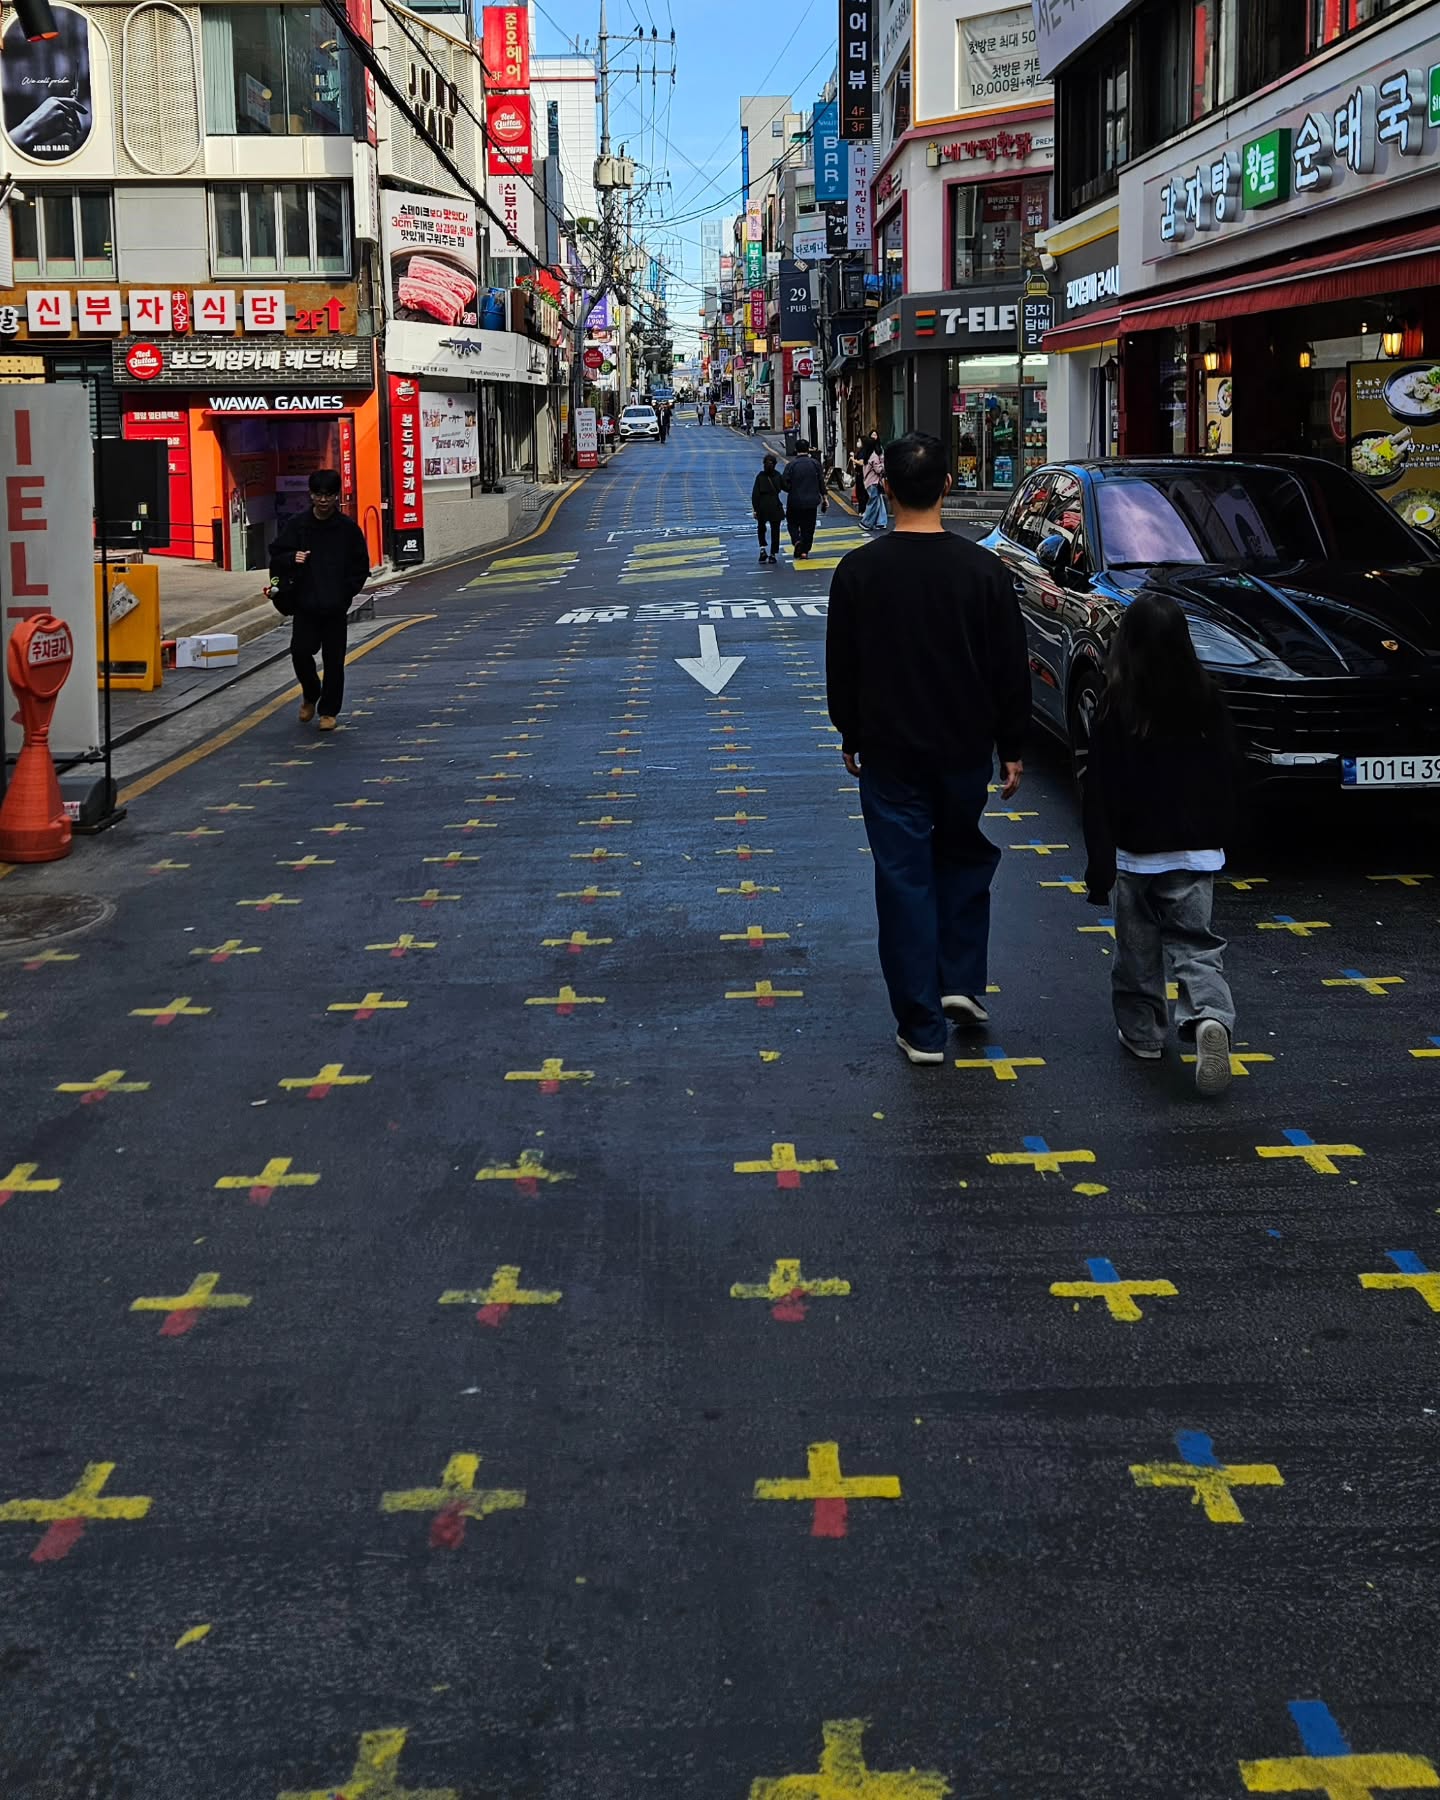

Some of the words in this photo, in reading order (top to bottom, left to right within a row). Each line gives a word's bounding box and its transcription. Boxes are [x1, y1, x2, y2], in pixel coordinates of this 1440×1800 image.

[505, 13, 522, 82] 준오헤어
[848, 0, 867, 90] 어더뷰
[969, 38, 996, 55] 첫방문
[1000, 33, 1019, 48] 최대
[491, 71, 503, 82] 3F
[992, 61, 1020, 79] 첫방문
[408, 62, 459, 118] JUNO
[501, 112, 516, 121] Red
[851, 106, 865, 117] 4F
[413, 102, 455, 151] HAIR
[494, 120, 523, 131] Button
[851, 121, 865, 132] 3F
[1294, 74, 1413, 191] 순대국
[943, 131, 1033, 161] 내가찜한닭
[823, 136, 839, 183] BAR
[1245, 145, 1276, 194] 황토
[855, 168, 867, 236] 내가찜한닭
[1160, 160, 1230, 242] 감자탕
[391, 216, 412, 229] 3cm
[401, 229, 426, 243] 맛있게
[749, 249, 760, 282] 부동산
[790, 288, 807, 301] 29
[36, 296, 278, 326] 신부자식당
[296, 310, 325, 330] 2F
[940, 305, 1018, 334] 7-ELE
[1025, 304, 1050, 316] 전자
[1025, 319, 1050, 331] 담배
[129, 357, 158, 368] Button
[136, 350, 151, 359] Red
[170, 351, 281, 370] 보드게임카페
[285, 350, 359, 370] 레드버튼
[209, 397, 268, 410] WAWA
[275, 396, 343, 410] GAMES
[400, 413, 416, 506] 보드게임카페
[32, 637, 67, 659] 주차금지
[1361, 760, 1414, 781] 101더
